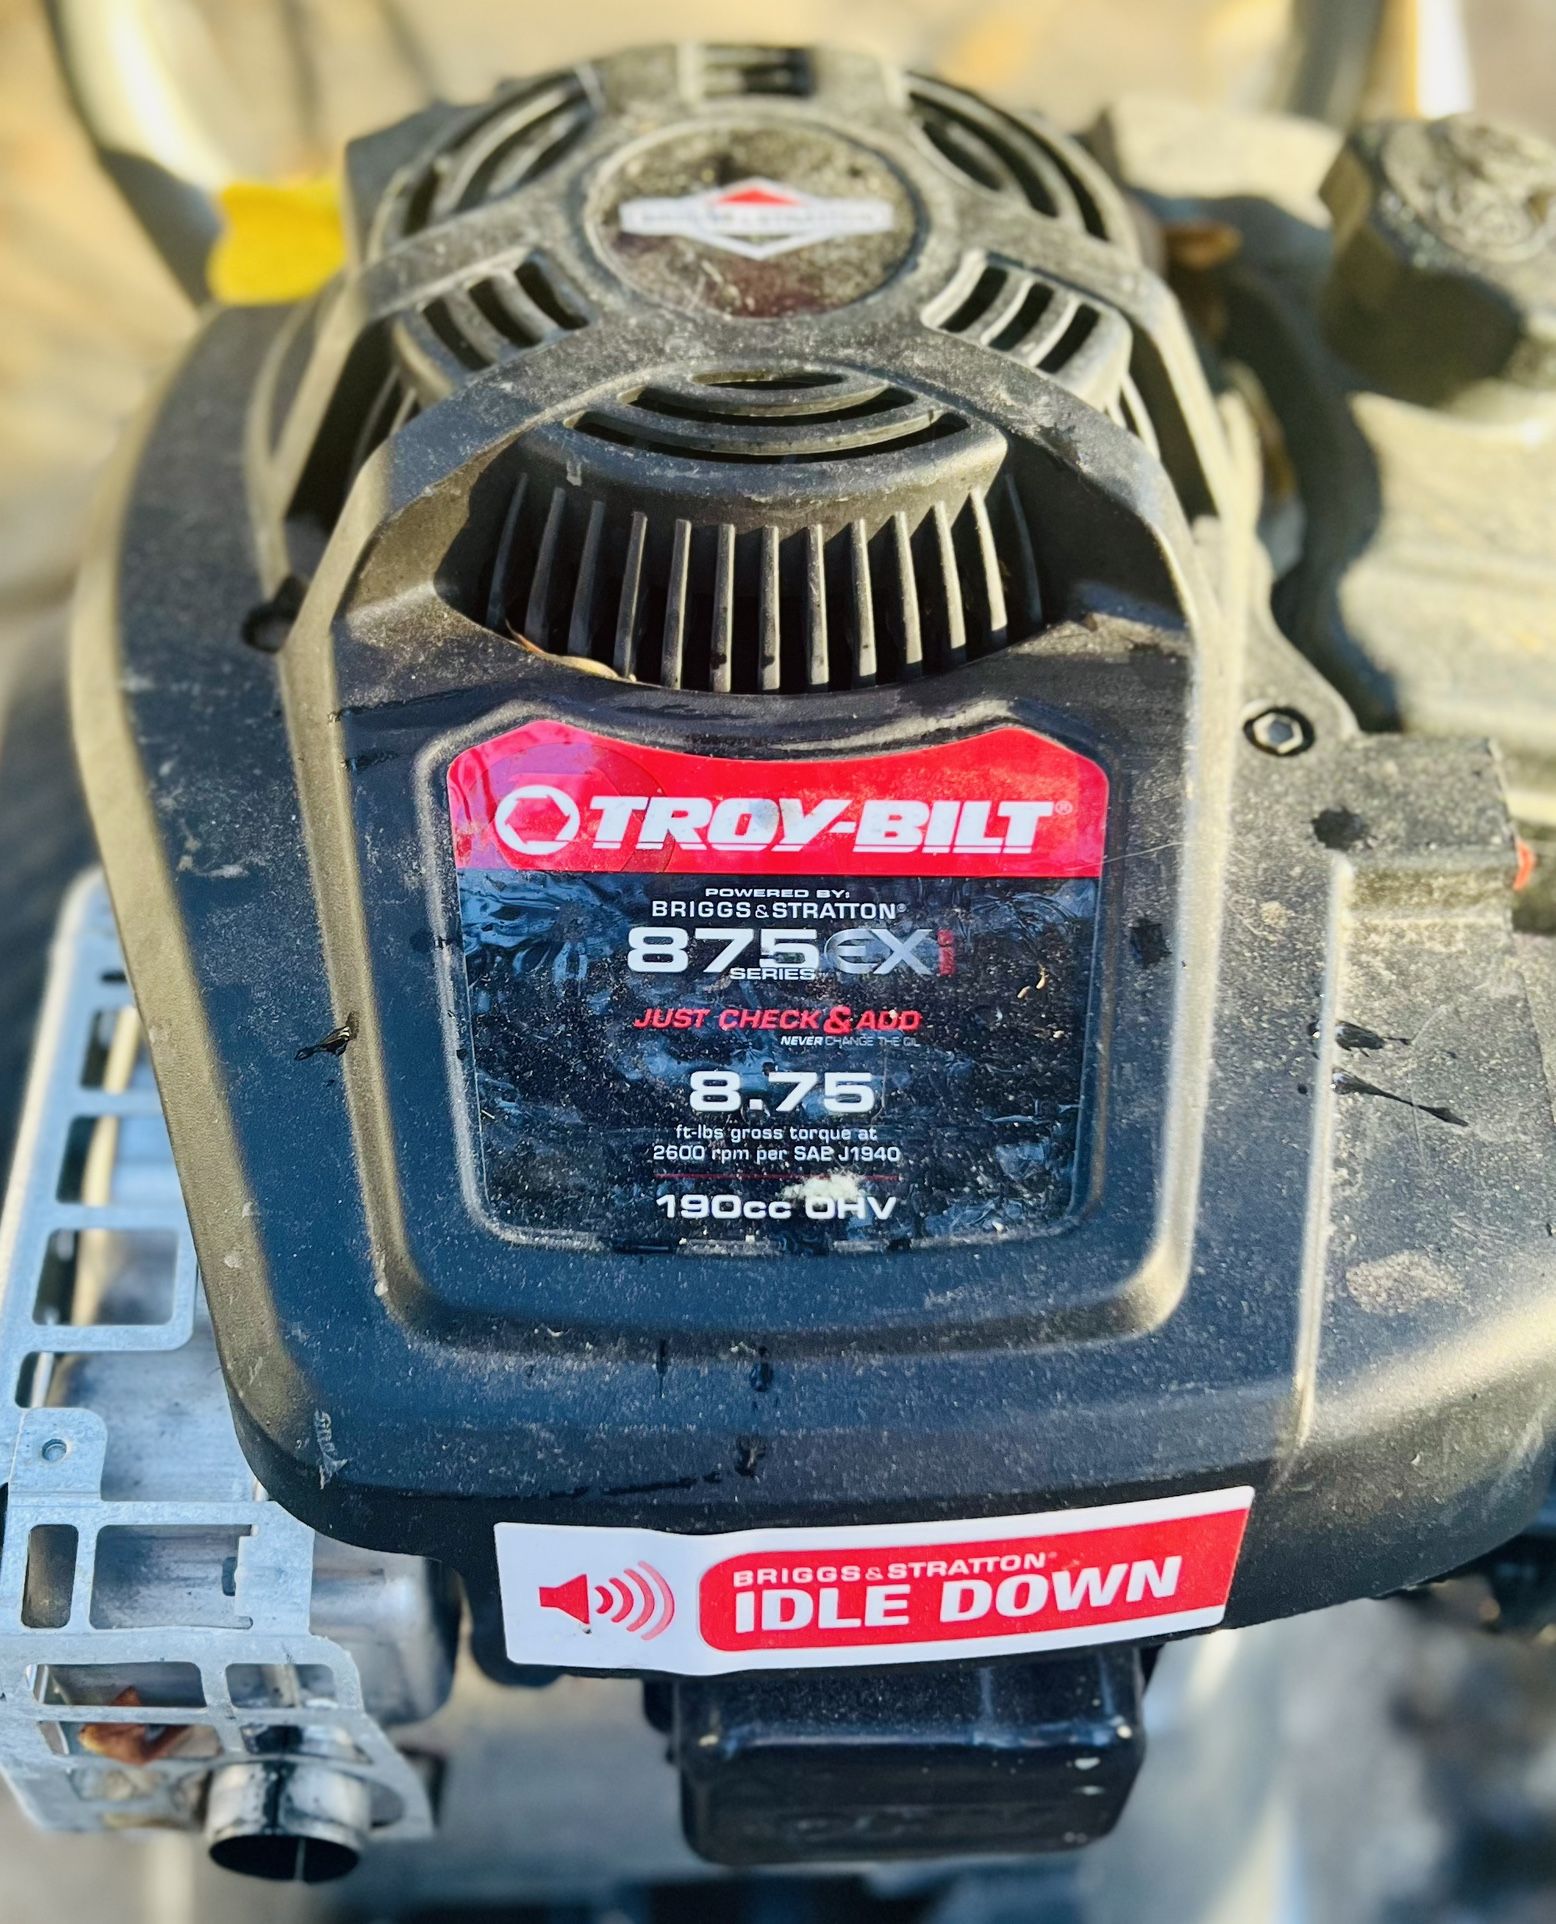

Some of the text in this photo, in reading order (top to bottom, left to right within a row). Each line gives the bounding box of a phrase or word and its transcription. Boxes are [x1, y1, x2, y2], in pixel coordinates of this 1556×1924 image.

[705, 888, 850, 898] POWERED BY:
[730, 967, 815, 981] SERIES
[634, 1008, 710, 1029] JUST
[718, 1008, 821, 1030] CHECK
[780, 1035, 920, 1047] NEVER CHANGE THE OIL
[689, 1070, 876, 1114] 8.75
[676, 1124, 878, 1144] ft-lbs gross torque at
[653, 1145, 901, 1164] 2600 rpm per SAE J1940
[656, 1194, 897, 1220] 190cc OHV
[735, 1555, 1183, 1634] IDLE DOWN
